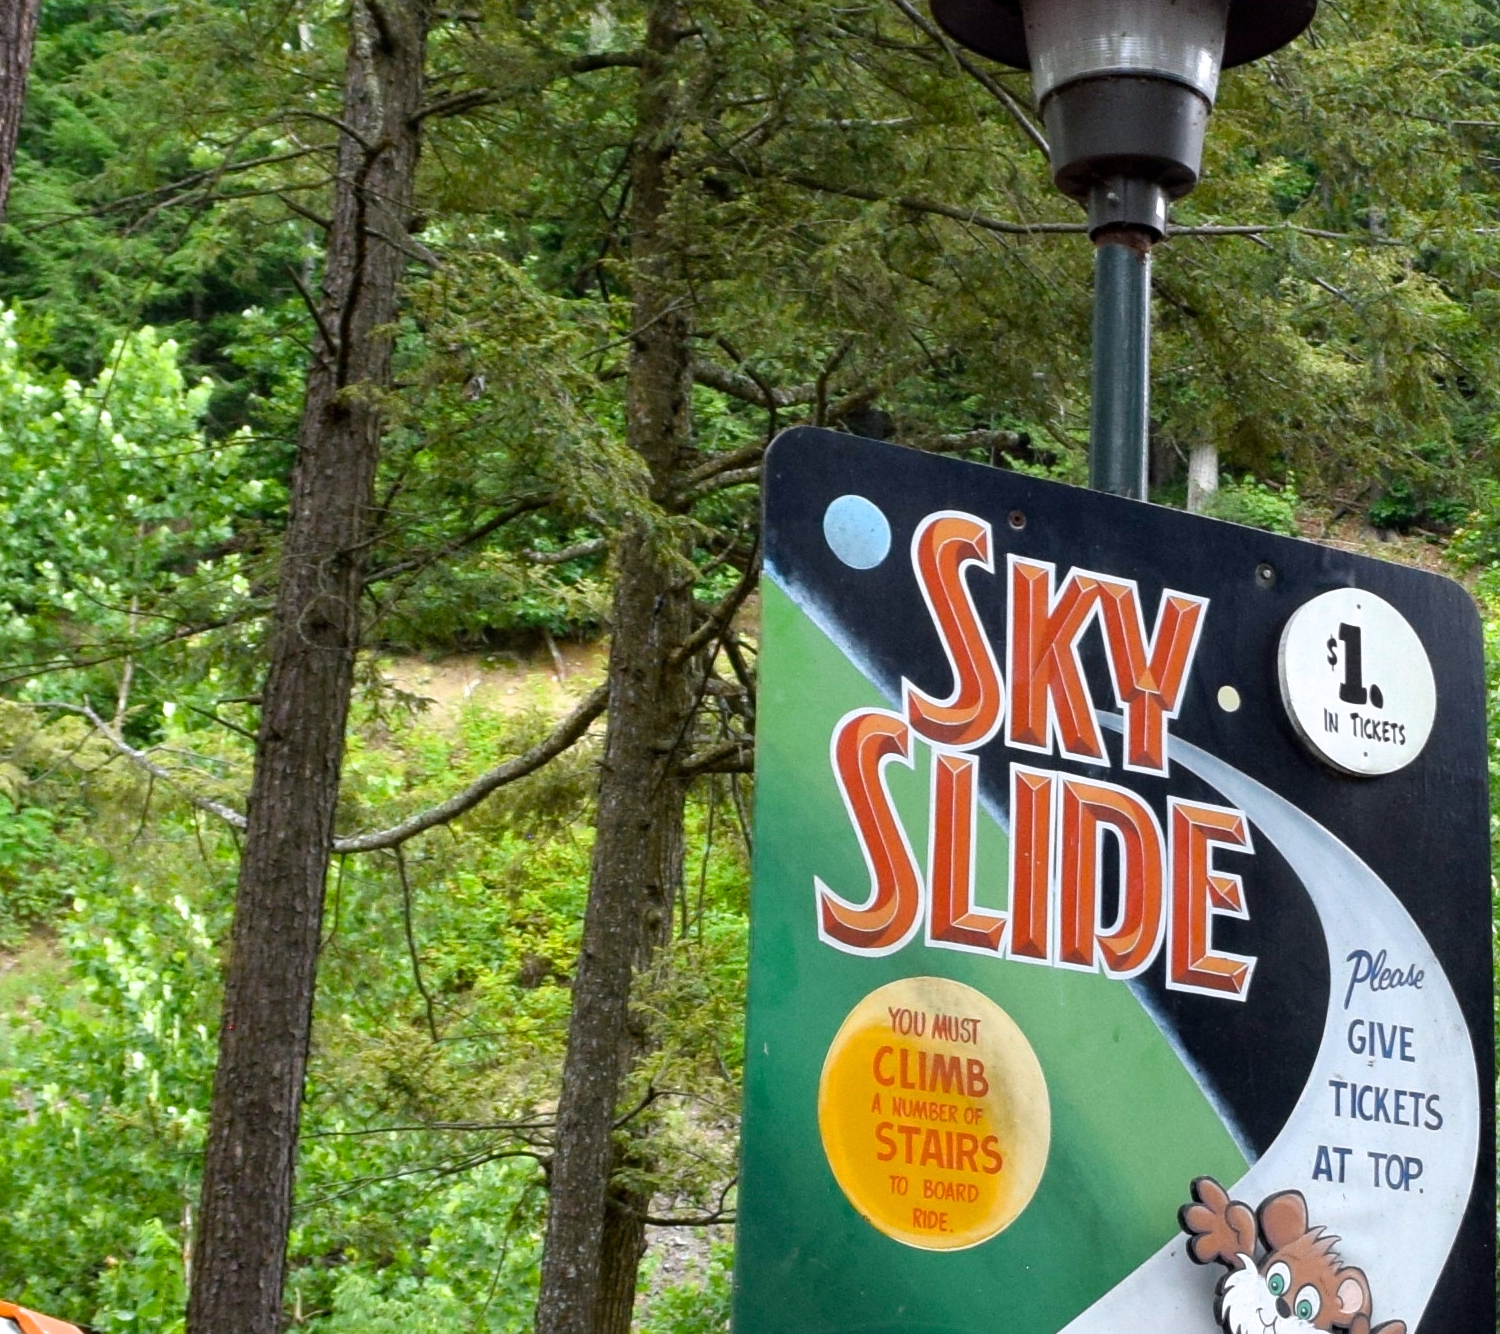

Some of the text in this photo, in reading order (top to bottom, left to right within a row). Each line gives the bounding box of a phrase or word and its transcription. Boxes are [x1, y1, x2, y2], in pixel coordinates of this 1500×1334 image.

[900, 509, 1211, 778] SKY
[1324, 707, 1406, 746] IN TICKETS
[813, 706, 1257, 1002] SLIDE
[1343, 949, 1425, 1010] Please
[888, 1007, 981, 1045] YOU MUST
[1347, 1019, 1416, 1063] GIVE
[872, 1046, 989, 1098] CLIMB
[871, 1092, 984, 1125] A NUMBER OF
[1328, 1079, 1443, 1131] TICKETS
[875, 1122, 1003, 1175] STAIRS
[1311, 1144, 1424, 1194] AT TOP.
[889, 1175, 979, 1204] TO BOARD
[912, 1207, 954, 1233] RIDE.
